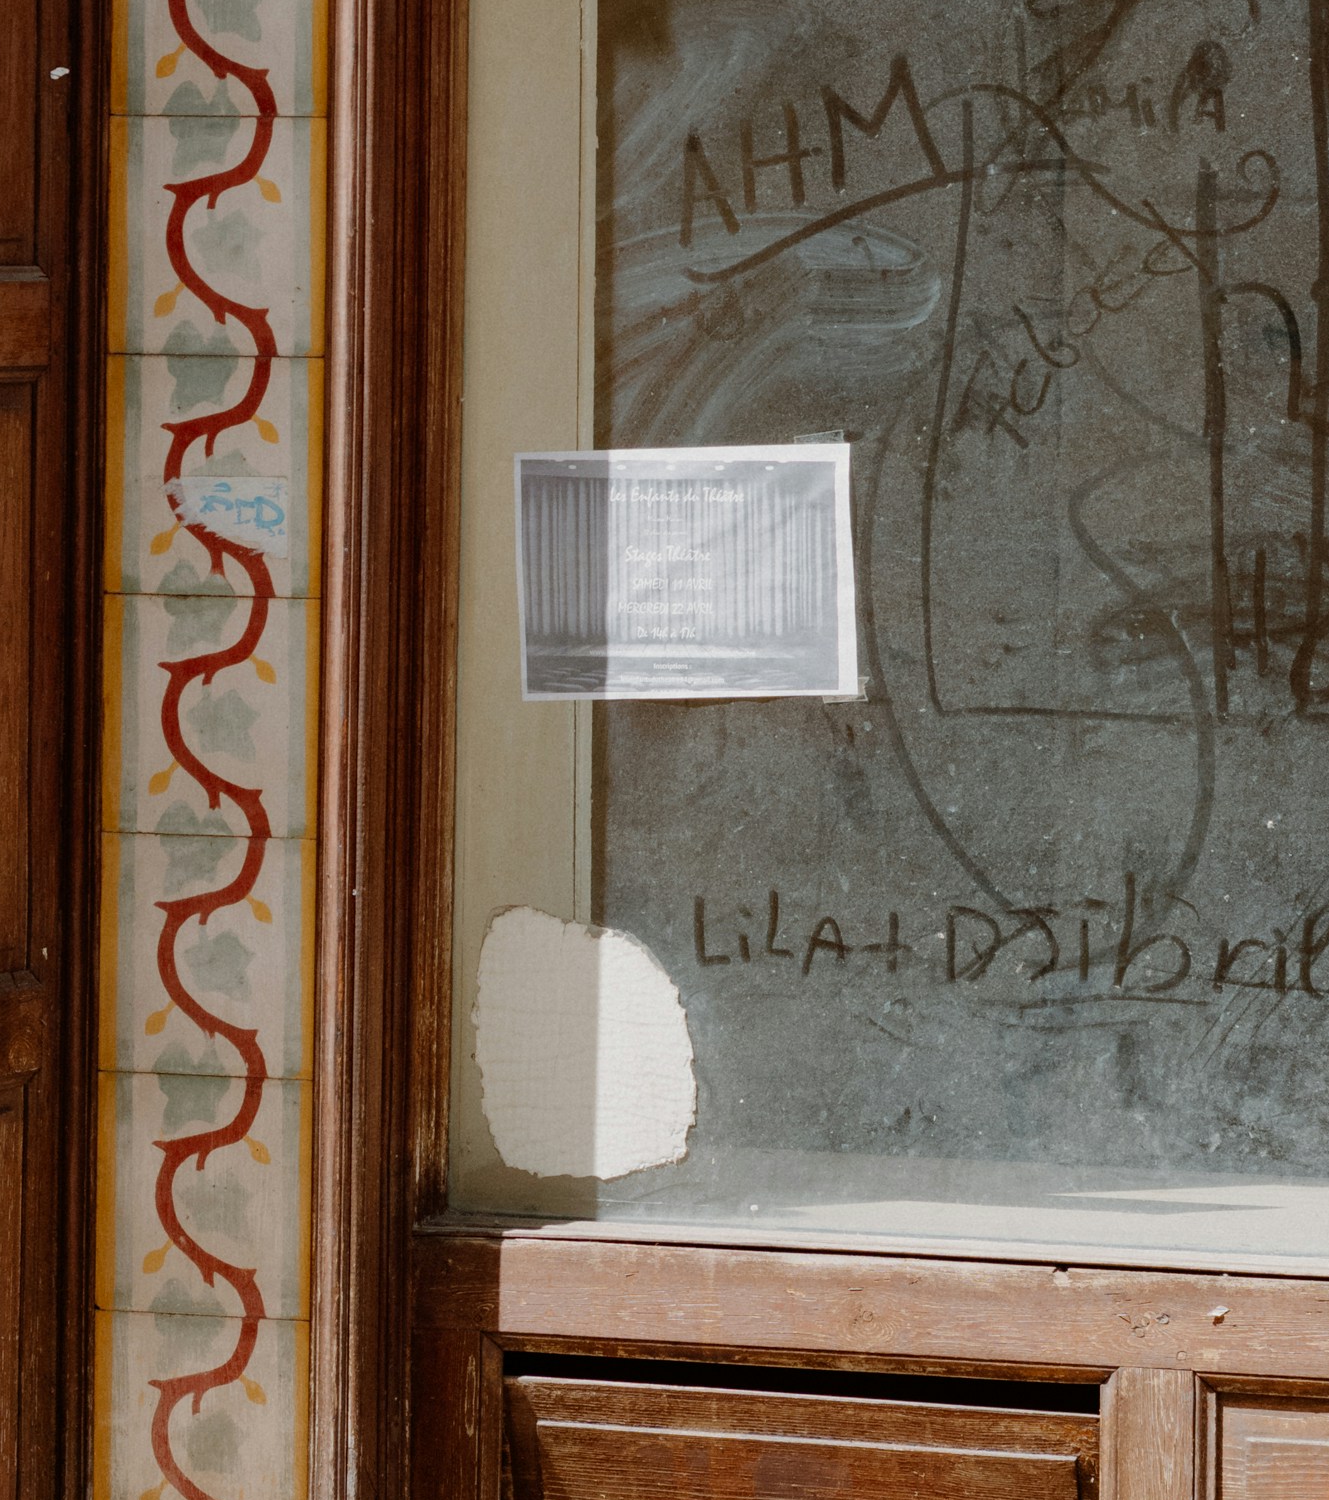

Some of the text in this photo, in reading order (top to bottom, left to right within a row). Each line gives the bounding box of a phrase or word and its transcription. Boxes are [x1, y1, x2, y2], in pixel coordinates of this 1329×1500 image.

[610, 486, 627, 502] Les
[631, 486, 678, 507] Enfants
[683, 487, 700, 502] du
[625, 545, 712, 567] Stages Théâtre
[632, 577, 713, 592] SAMEDI 11 AVRIL
[618, 602, 714, 615] MERCREDI 22 AVRIL
[653, 663, 688, 671] Inscriptions
